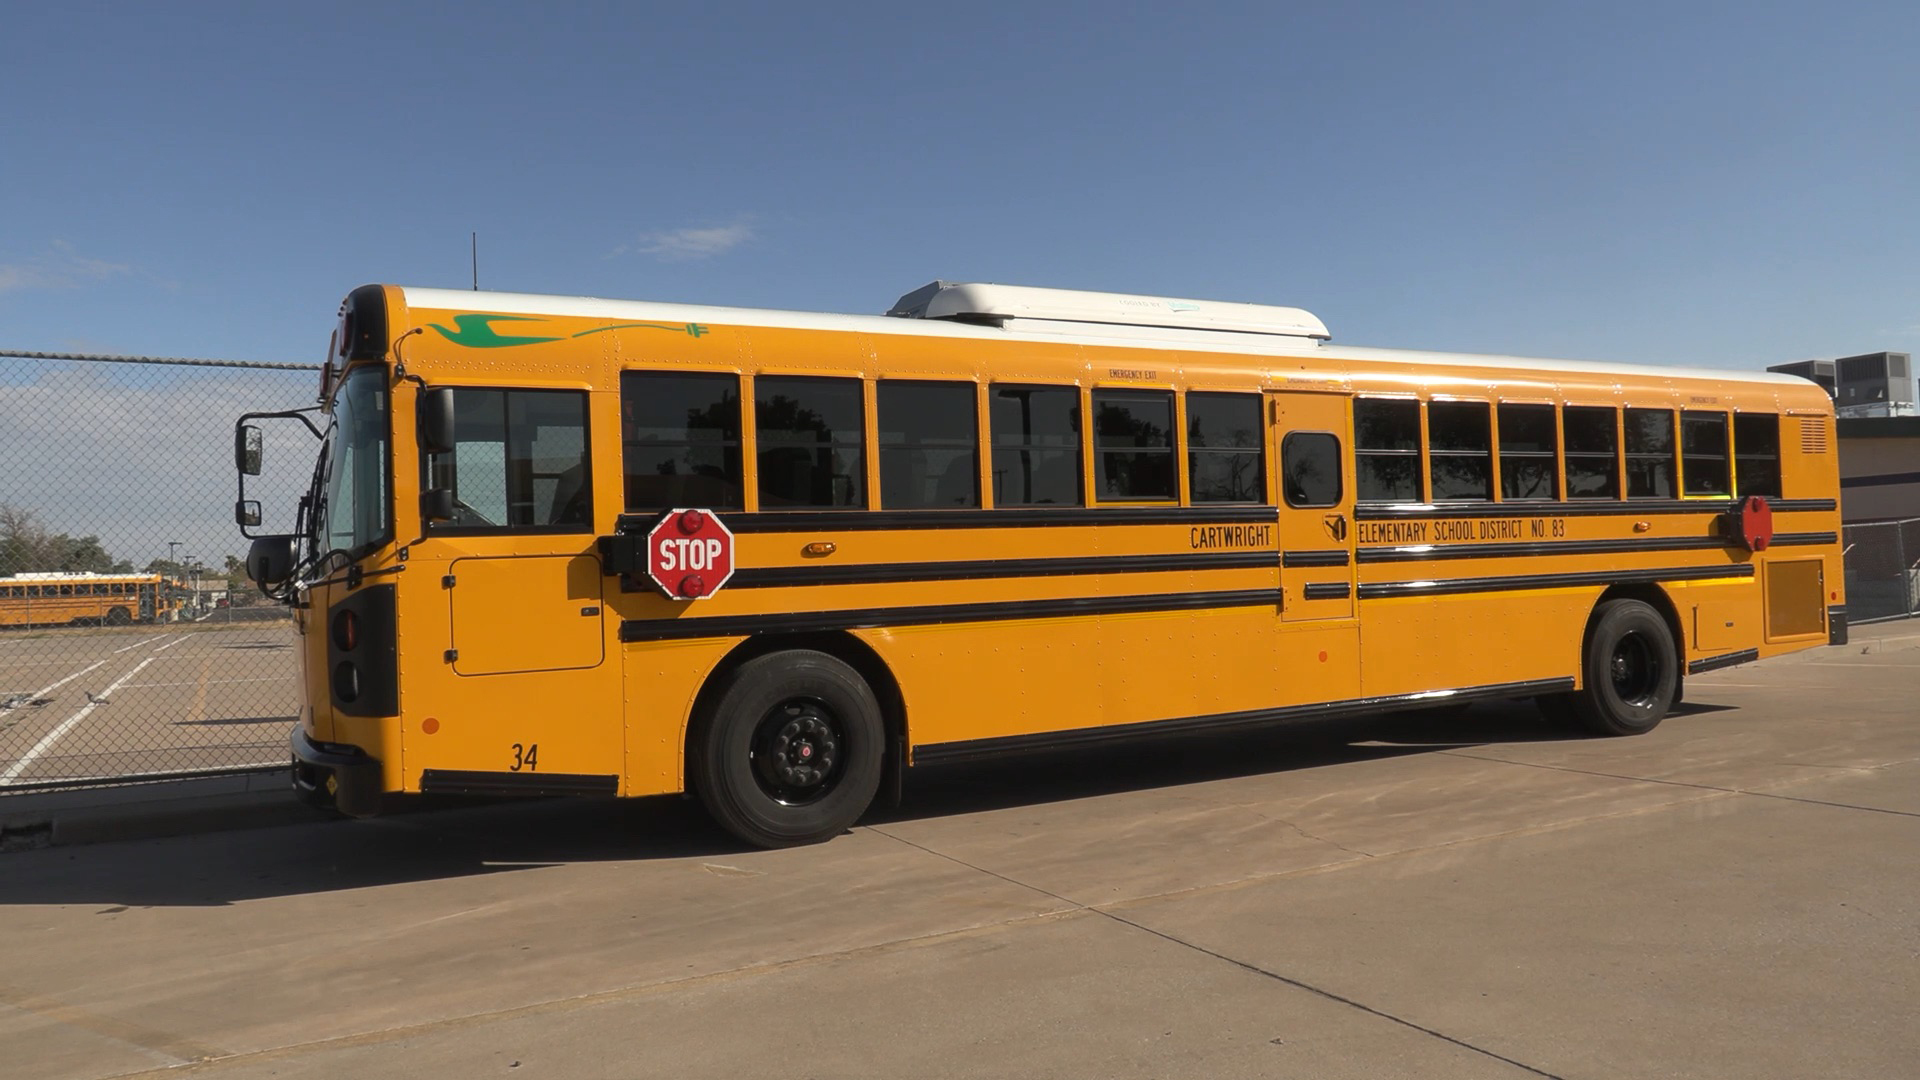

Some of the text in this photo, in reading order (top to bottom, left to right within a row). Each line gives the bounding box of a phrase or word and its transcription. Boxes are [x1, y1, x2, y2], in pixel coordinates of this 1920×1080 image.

[1109, 369, 1157, 380] EMERGENCY EXIT
[1191, 519, 1565, 549] CARTWRIGHT ELEMENTARY SCHOOL DISTRICT NO. 83
[660, 538, 722, 571] STOP
[510, 743, 538, 771] 34
